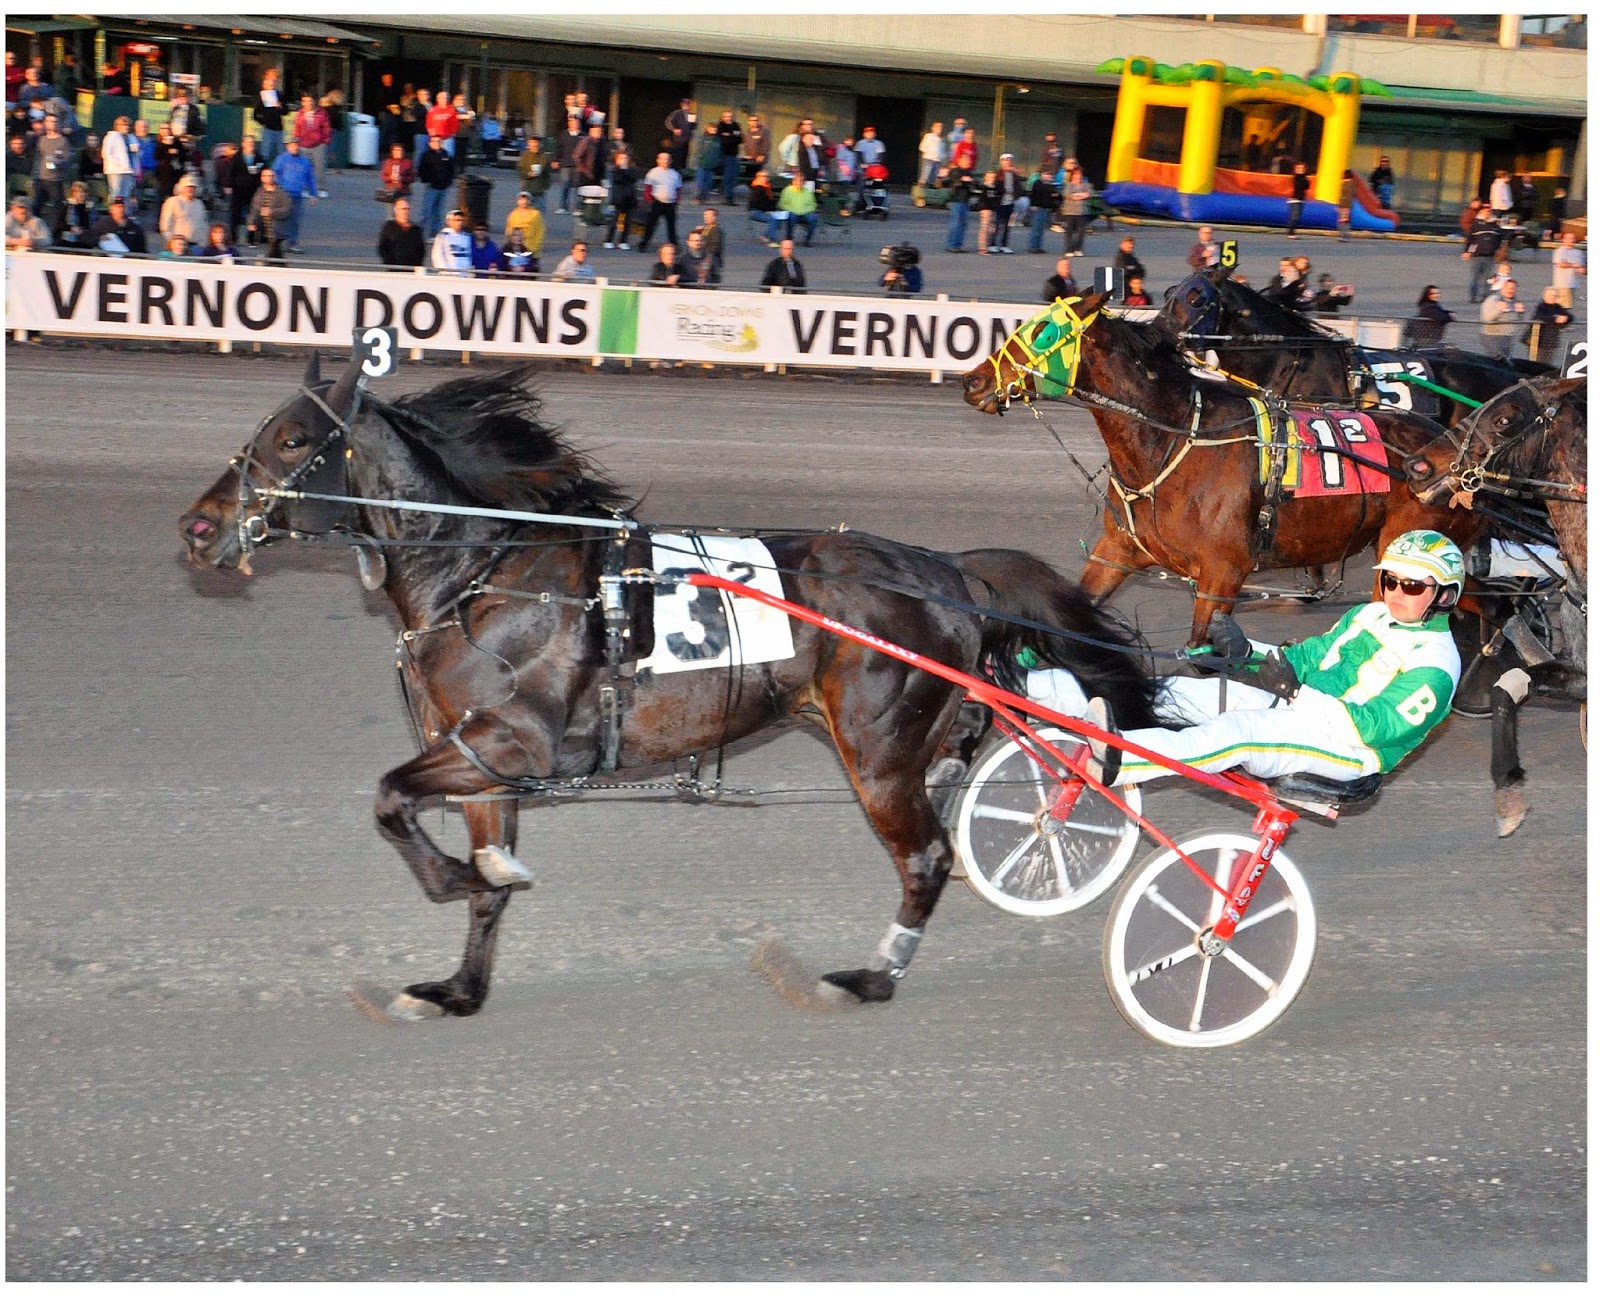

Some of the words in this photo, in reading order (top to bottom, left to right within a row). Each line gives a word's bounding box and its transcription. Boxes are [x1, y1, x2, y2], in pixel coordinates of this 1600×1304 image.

[1221, 240, 1237, 267] 5
[42, 269, 329, 334] VERNON
[355, 288, 589, 346] DOWNS
[361, 327, 392, 377] 3
[1566, 341, 1588, 380] 2
[1396, 683, 1438, 727] B
